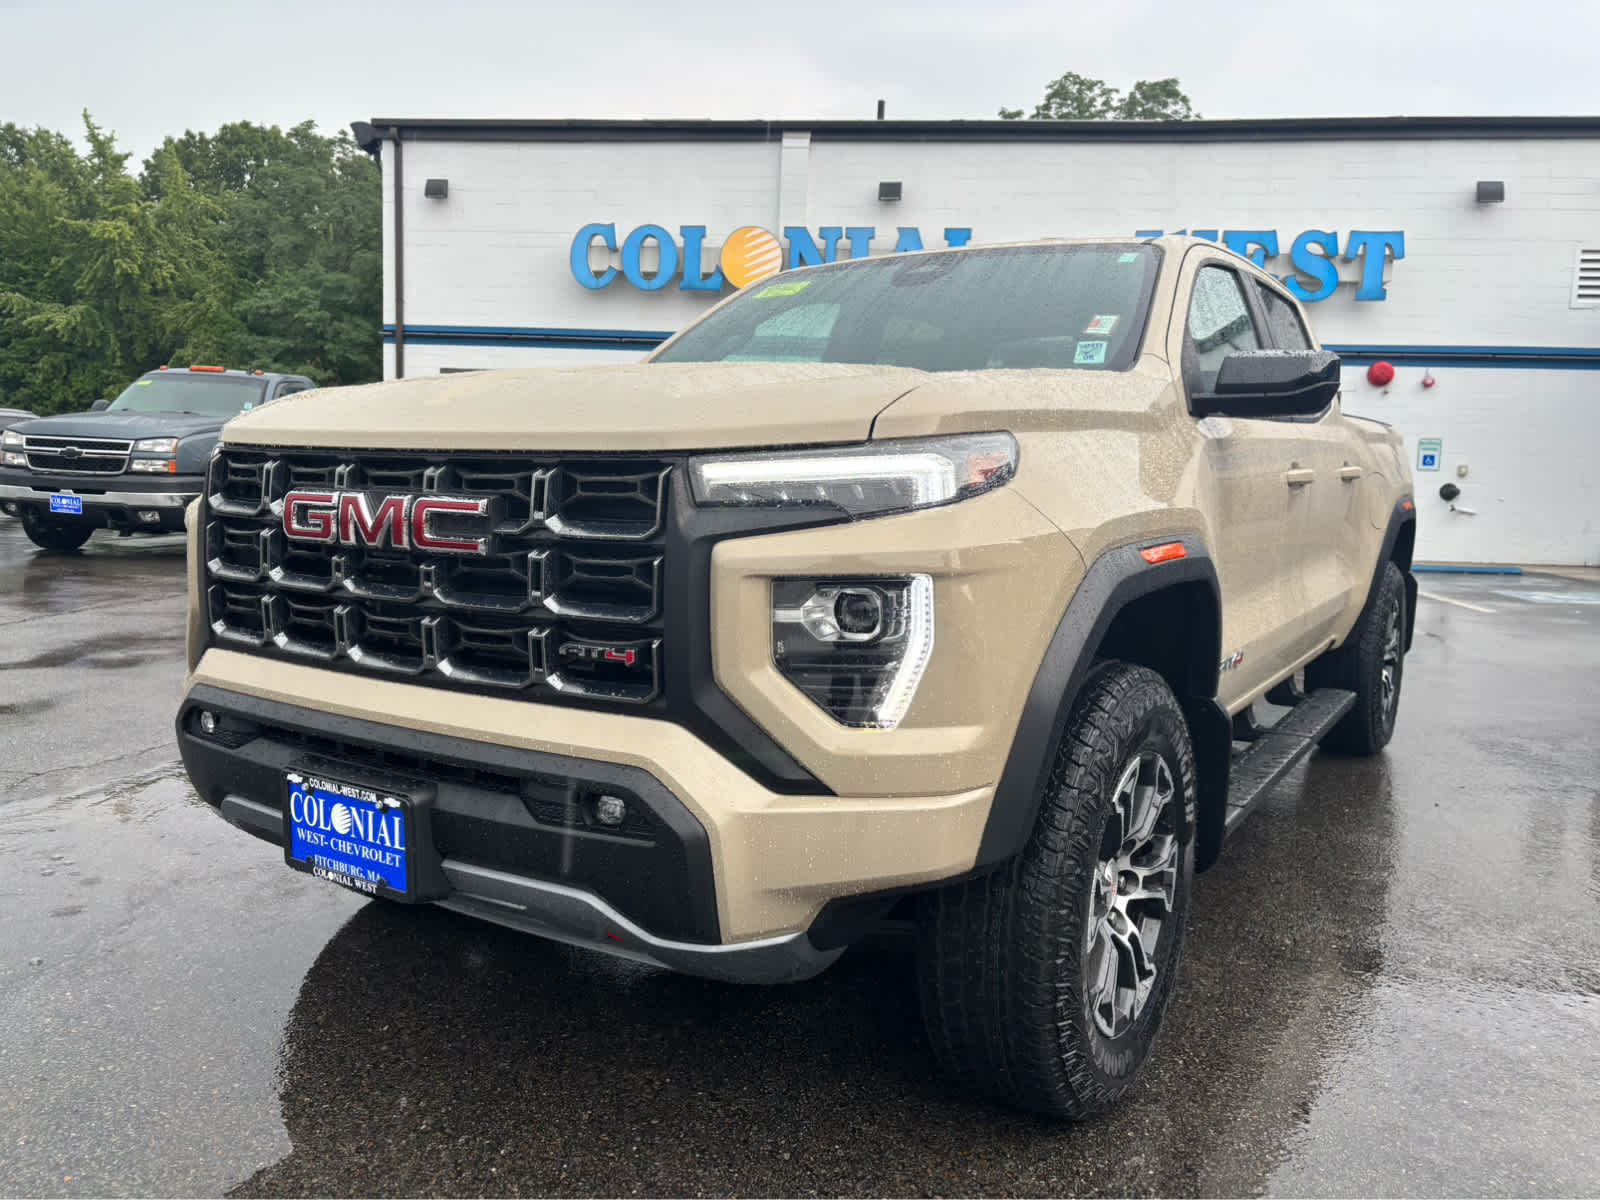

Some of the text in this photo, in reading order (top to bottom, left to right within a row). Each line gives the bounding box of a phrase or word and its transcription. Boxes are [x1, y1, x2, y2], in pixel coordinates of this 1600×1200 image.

[1136, 229, 1404, 301] EST
[283, 490, 488, 555] GMC
[290, 791, 406, 850] COLONIAL
[313, 866, 378, 894] COLONIAL WEST
[330, 837, 402, 868] CHEVROLET
